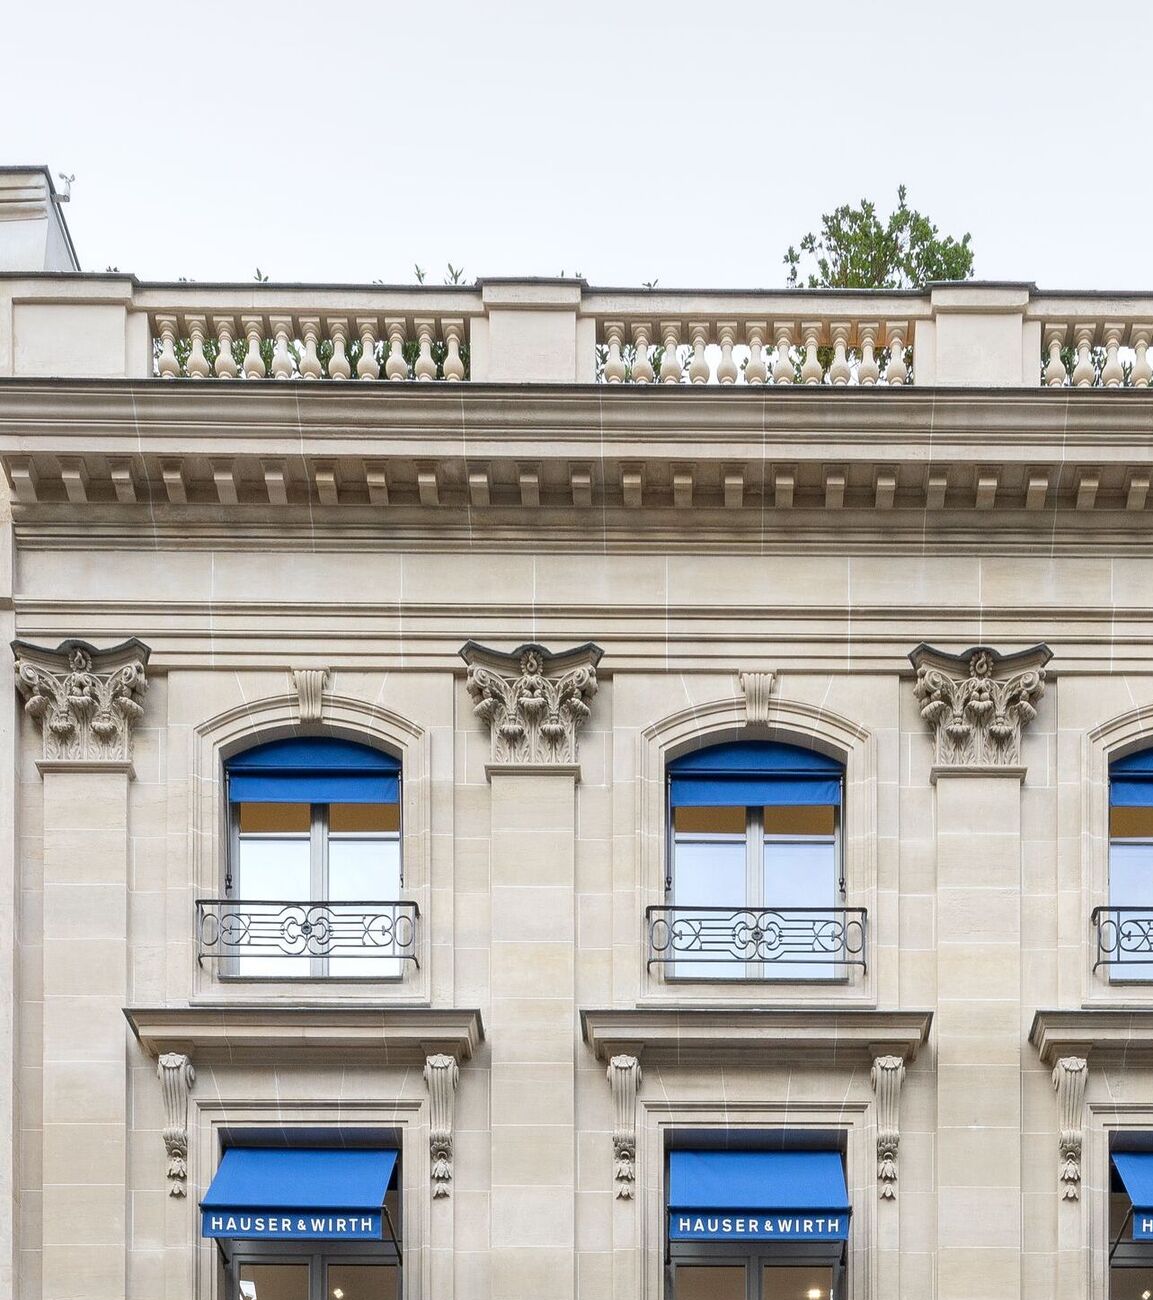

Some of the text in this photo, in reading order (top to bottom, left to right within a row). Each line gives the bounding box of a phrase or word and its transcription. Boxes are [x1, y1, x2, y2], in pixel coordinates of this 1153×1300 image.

[211, 1216, 372, 1232] HAUSER & WIRTH
[679, 1217, 839, 1233] HAUSER & WIRTH
